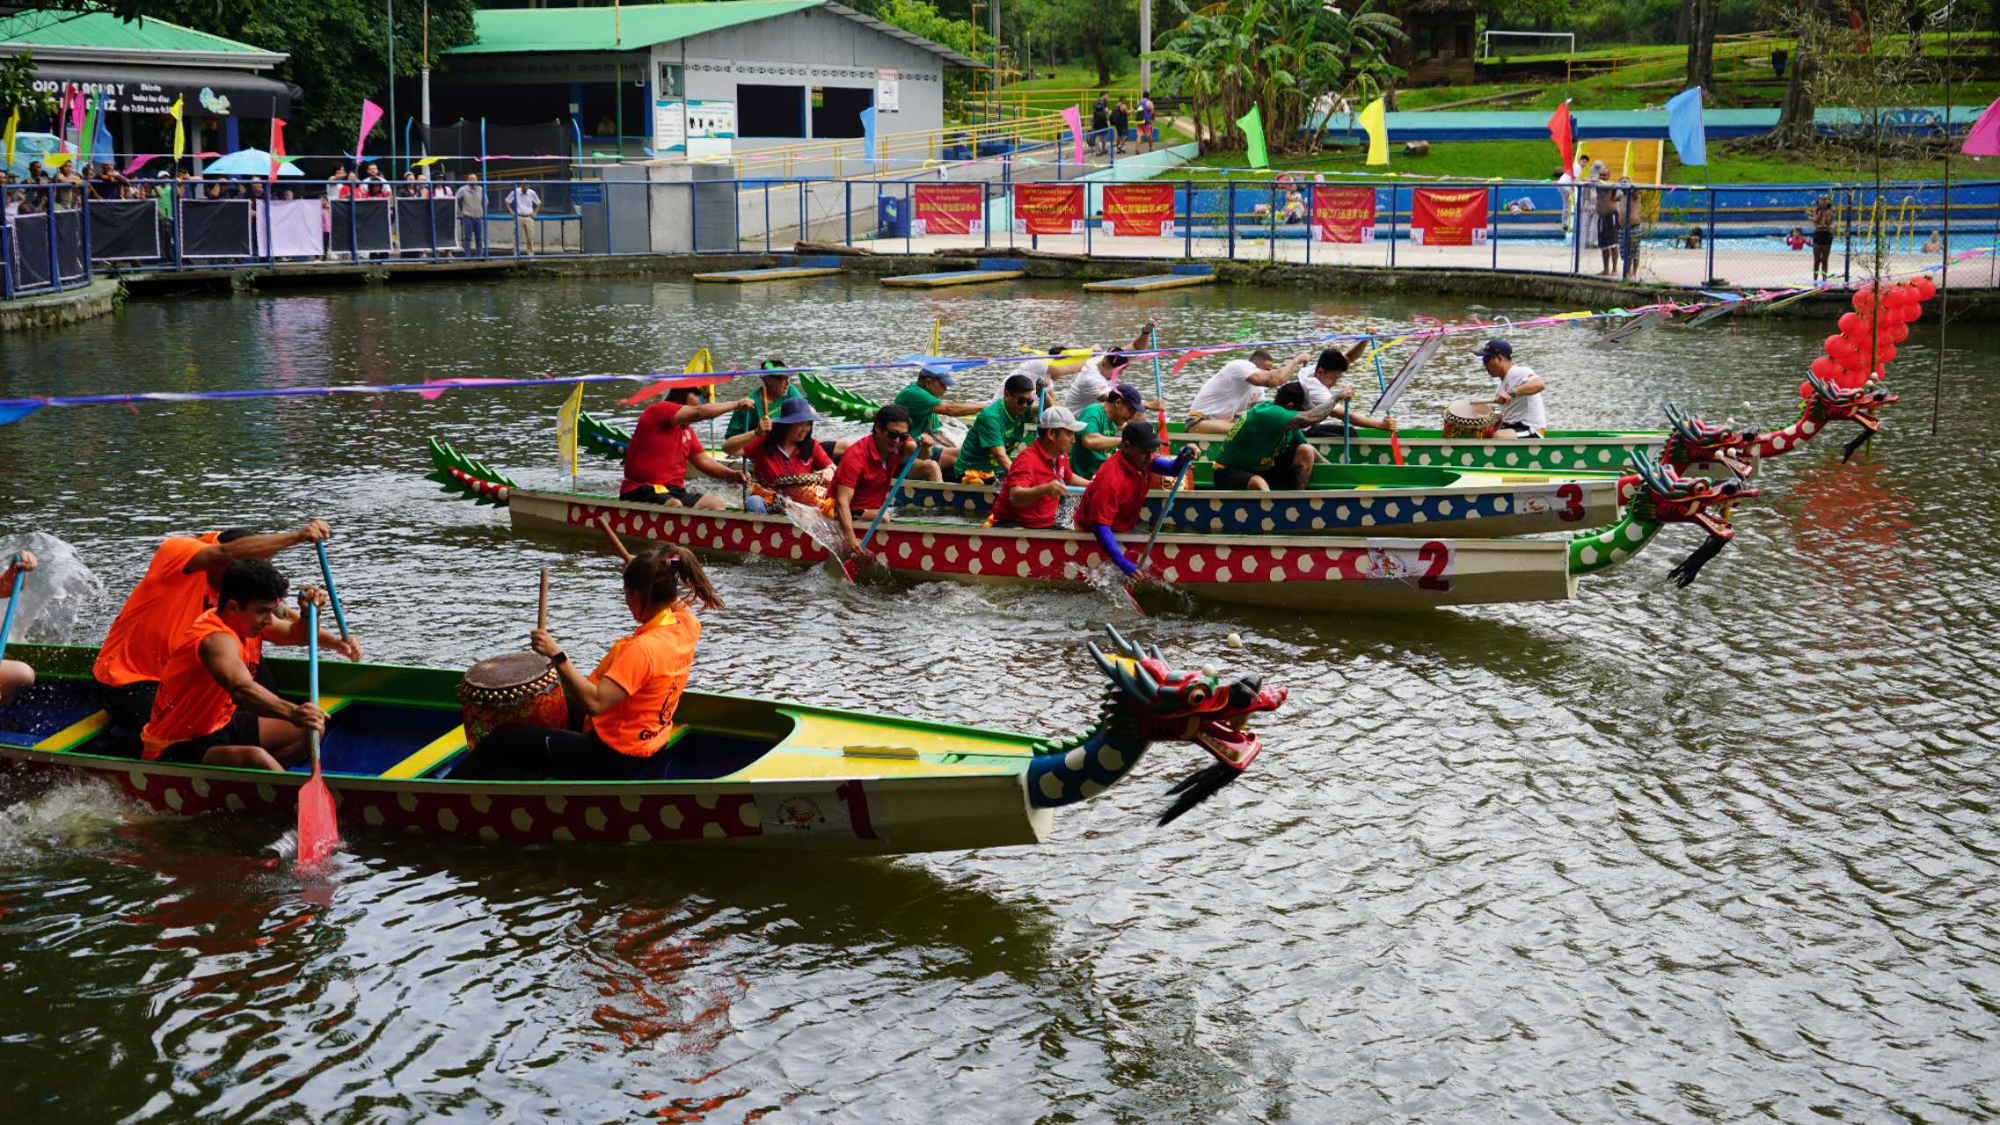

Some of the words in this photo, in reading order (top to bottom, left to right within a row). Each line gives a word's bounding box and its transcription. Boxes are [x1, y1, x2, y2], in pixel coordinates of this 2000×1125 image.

[32, 80, 58, 93] OJO
[82, 83, 115, 96] AGUA
[116, 84, 125, 96] Y
[1556, 483, 1585, 523] 3
[1418, 540, 1450, 592] 2
[835, 778, 880, 840] 1
